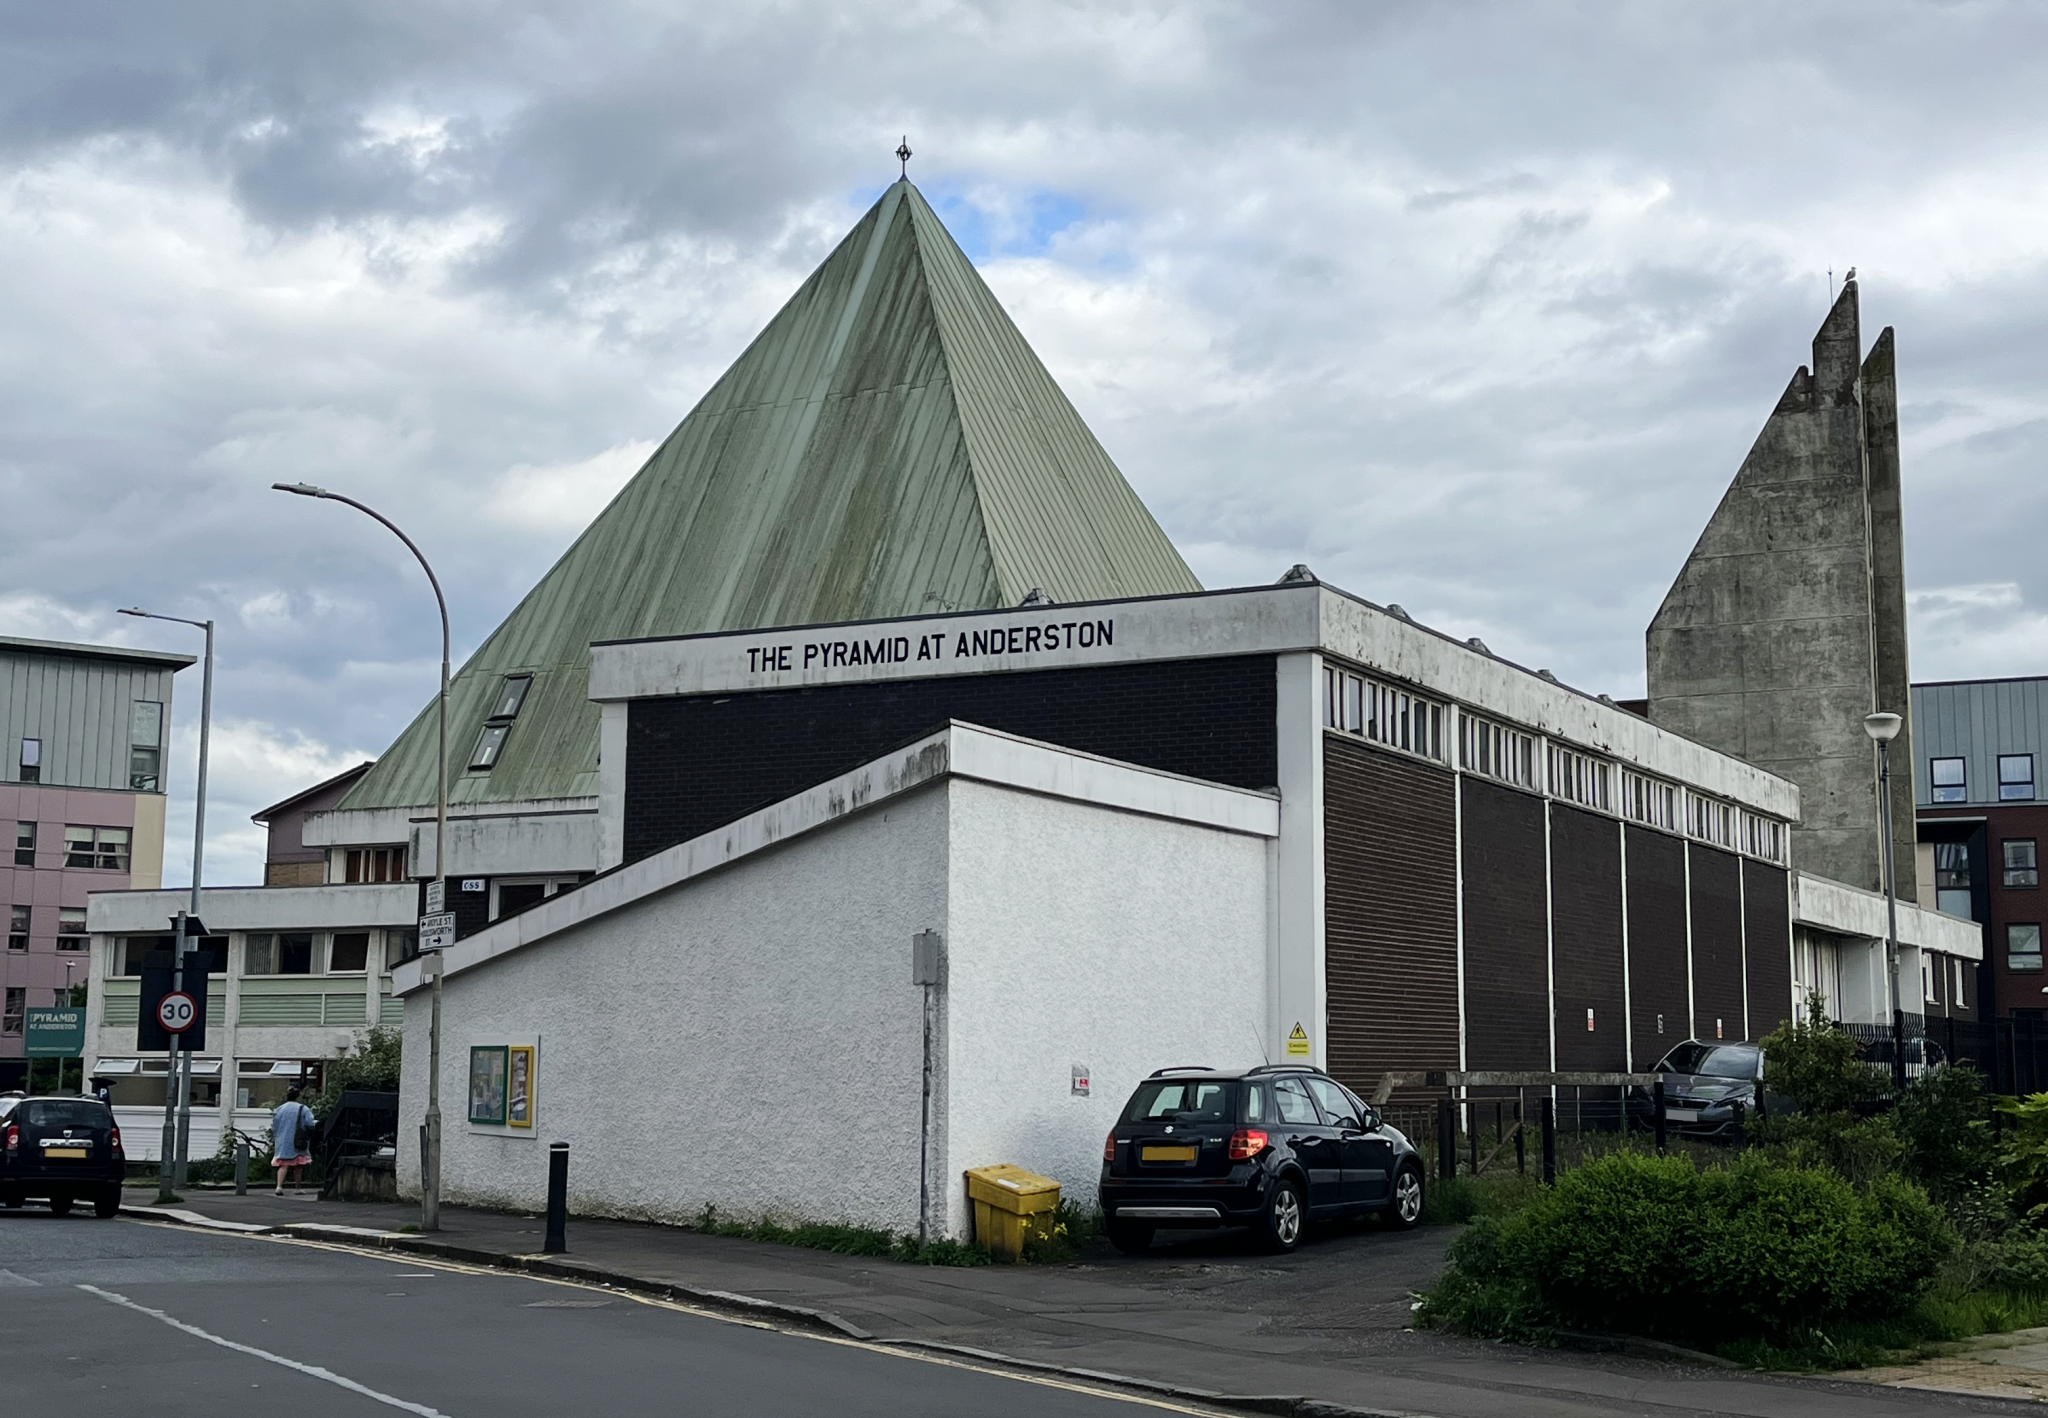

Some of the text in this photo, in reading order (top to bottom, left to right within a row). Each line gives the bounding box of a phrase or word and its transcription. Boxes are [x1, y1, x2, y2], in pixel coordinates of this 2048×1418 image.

[747, 619, 1114, 673] THE PYRAMID AT ANDERSTON
[464, 881, 480, 890] CSS
[162, 1003, 192, 1020] 30
[32, 1013, 78, 1023] PYRAMID
[100, 1088, 107, 1098] P
